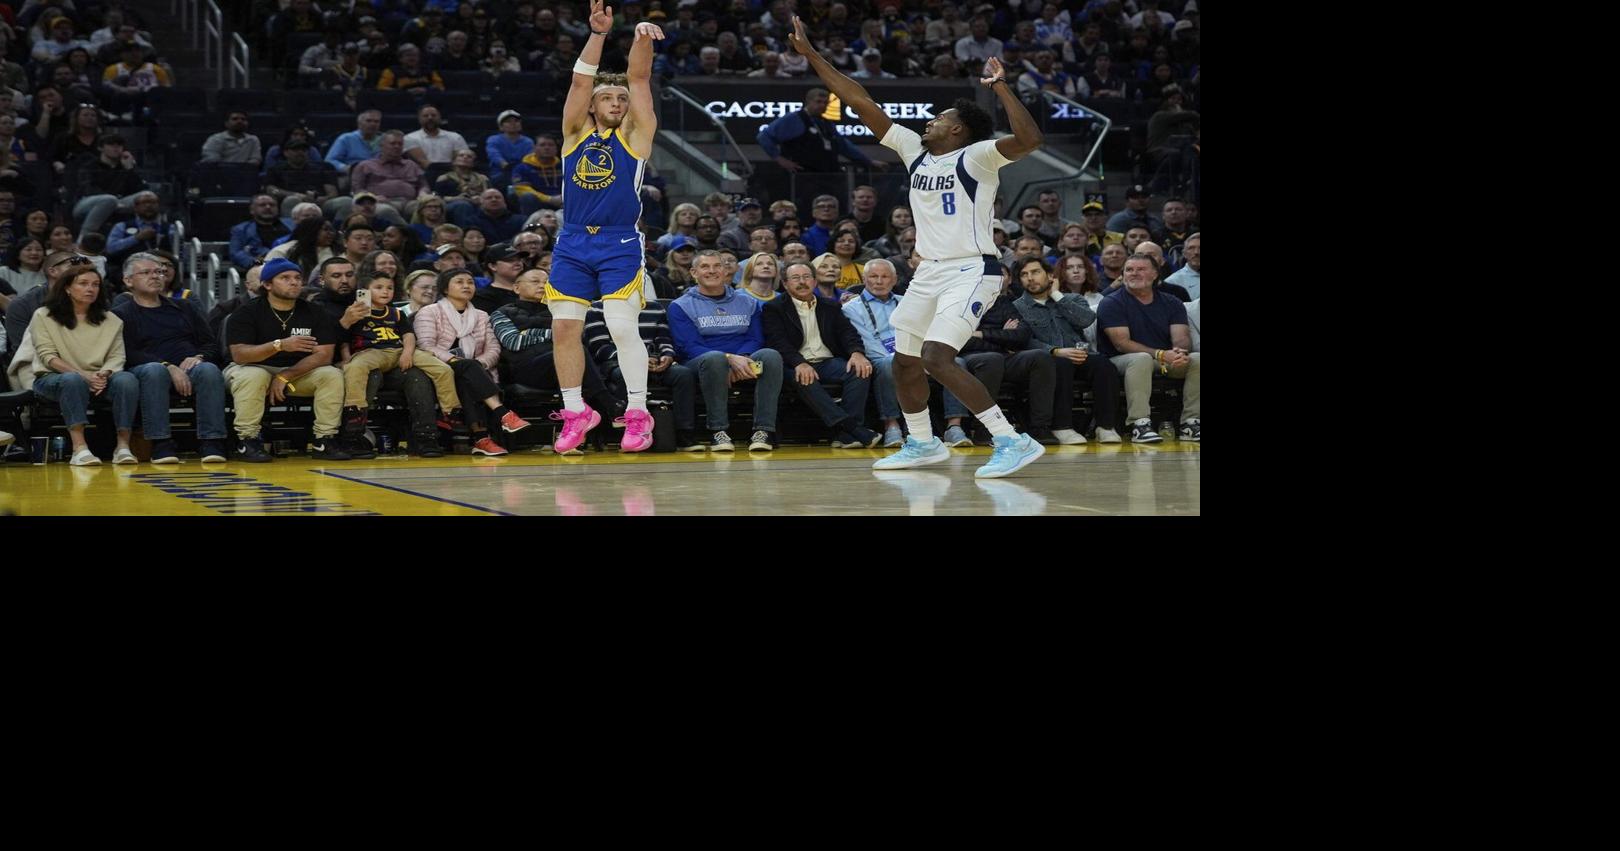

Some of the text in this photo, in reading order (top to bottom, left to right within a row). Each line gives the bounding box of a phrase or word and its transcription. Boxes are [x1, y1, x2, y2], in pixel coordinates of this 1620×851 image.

[845, 102, 935, 118] CEEK
[598, 154, 607, 165] 2
[571, 173, 617, 190] WARRIORS
[911, 173, 955, 191] DALAS
[941, 192, 956, 215] 8
